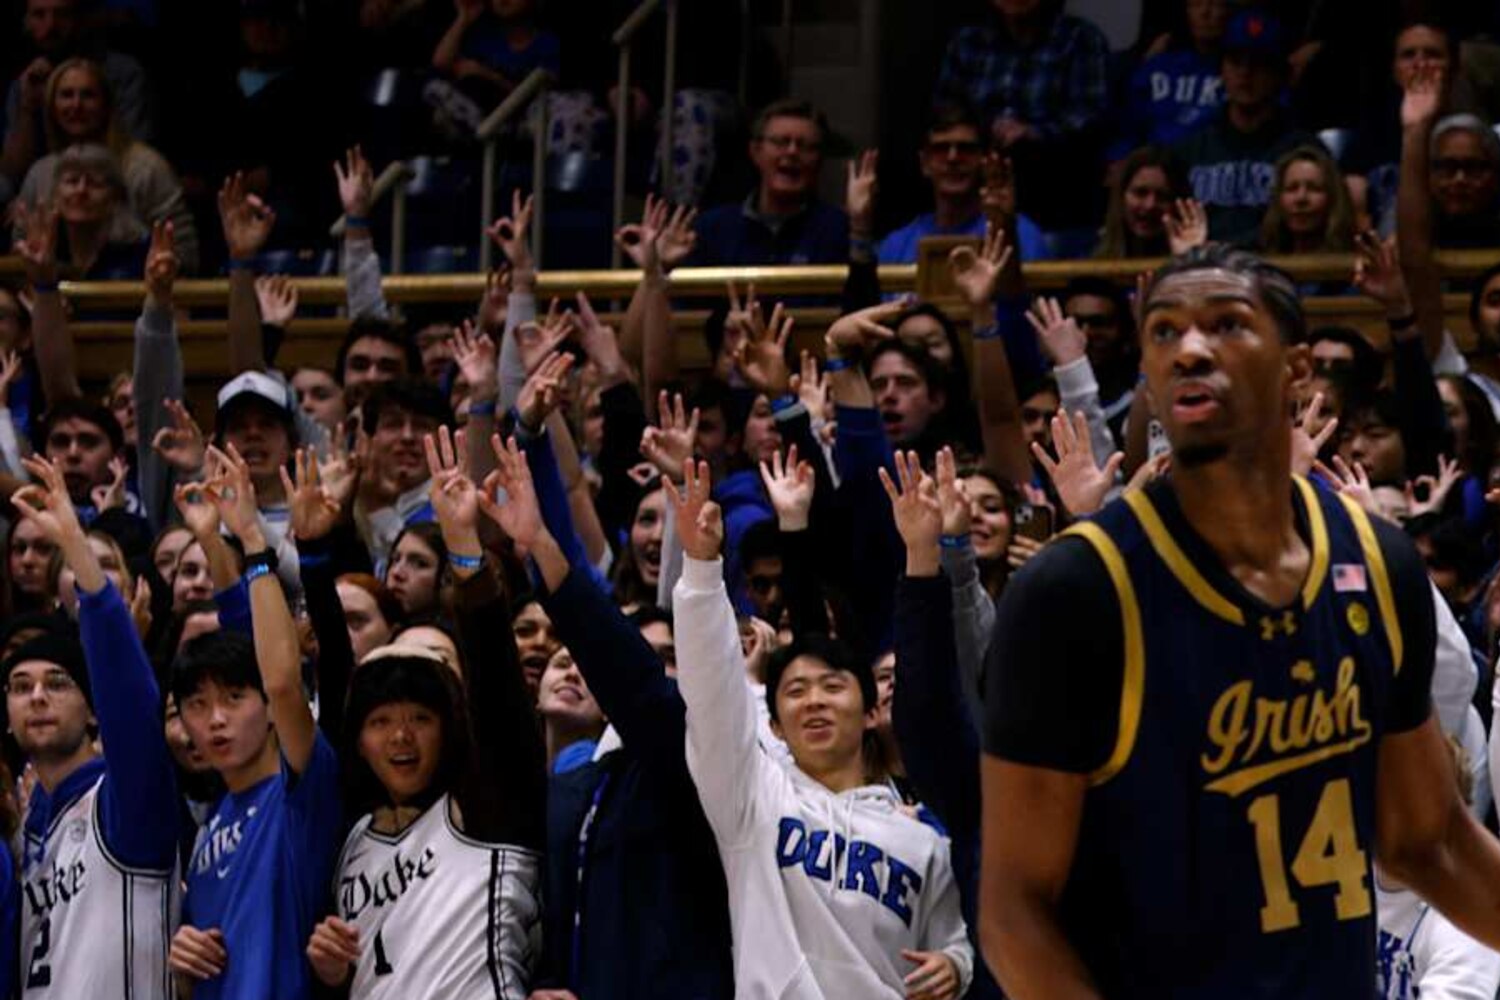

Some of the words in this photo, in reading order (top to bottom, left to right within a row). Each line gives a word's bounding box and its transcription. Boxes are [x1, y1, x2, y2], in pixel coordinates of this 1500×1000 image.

[1151, 71, 1229, 107] DUK
[1202, 656, 1371, 774] Irish
[23, 858, 86, 917] uke
[341, 847, 437, 920] Duke
[776, 816, 922, 931] DUKE
[1247, 777, 1372, 934] 14
